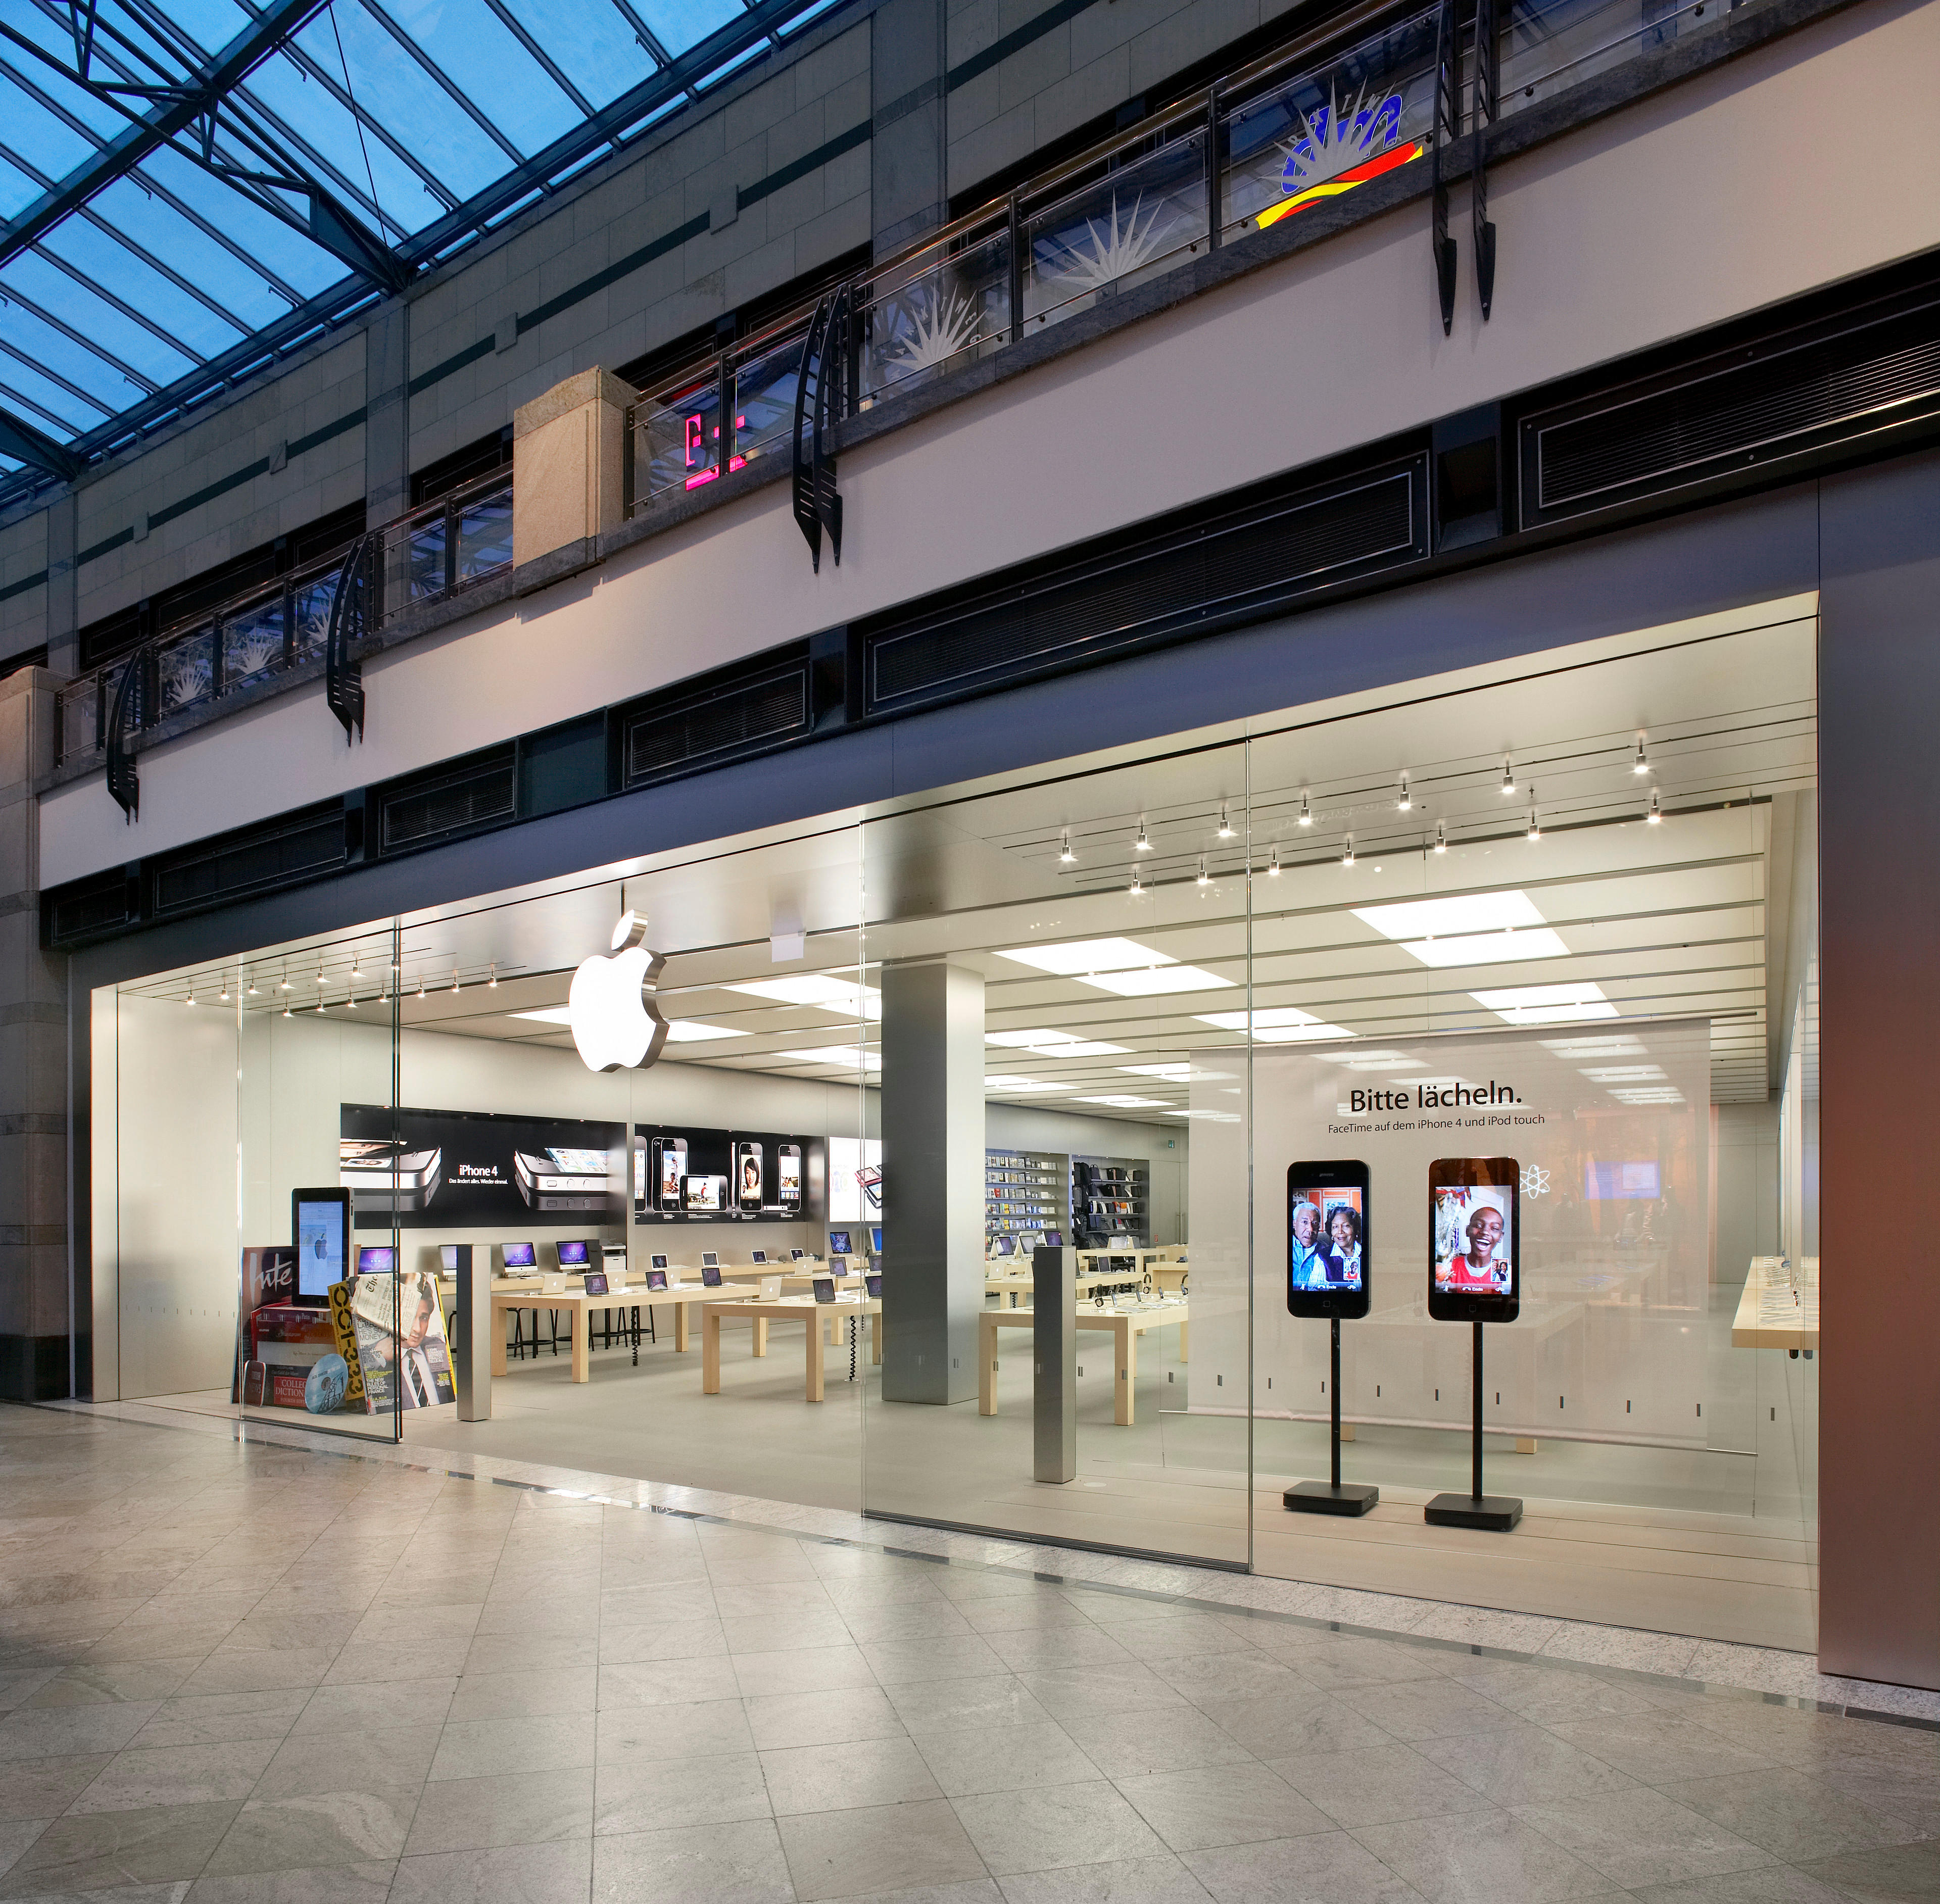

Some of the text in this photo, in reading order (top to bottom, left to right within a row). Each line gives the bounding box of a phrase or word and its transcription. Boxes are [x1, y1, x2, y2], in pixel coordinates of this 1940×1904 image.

[1350, 1080, 1522, 1112] Bitte lächeln.
[1329, 1114, 1545, 1134] FaceTime auf dem iPhone 4 und iPod touch
[459, 1164, 498, 1177] iPhone 4
[359, 1333, 381, 1341] MONEY
[275, 1387, 306, 1397] DICTION
